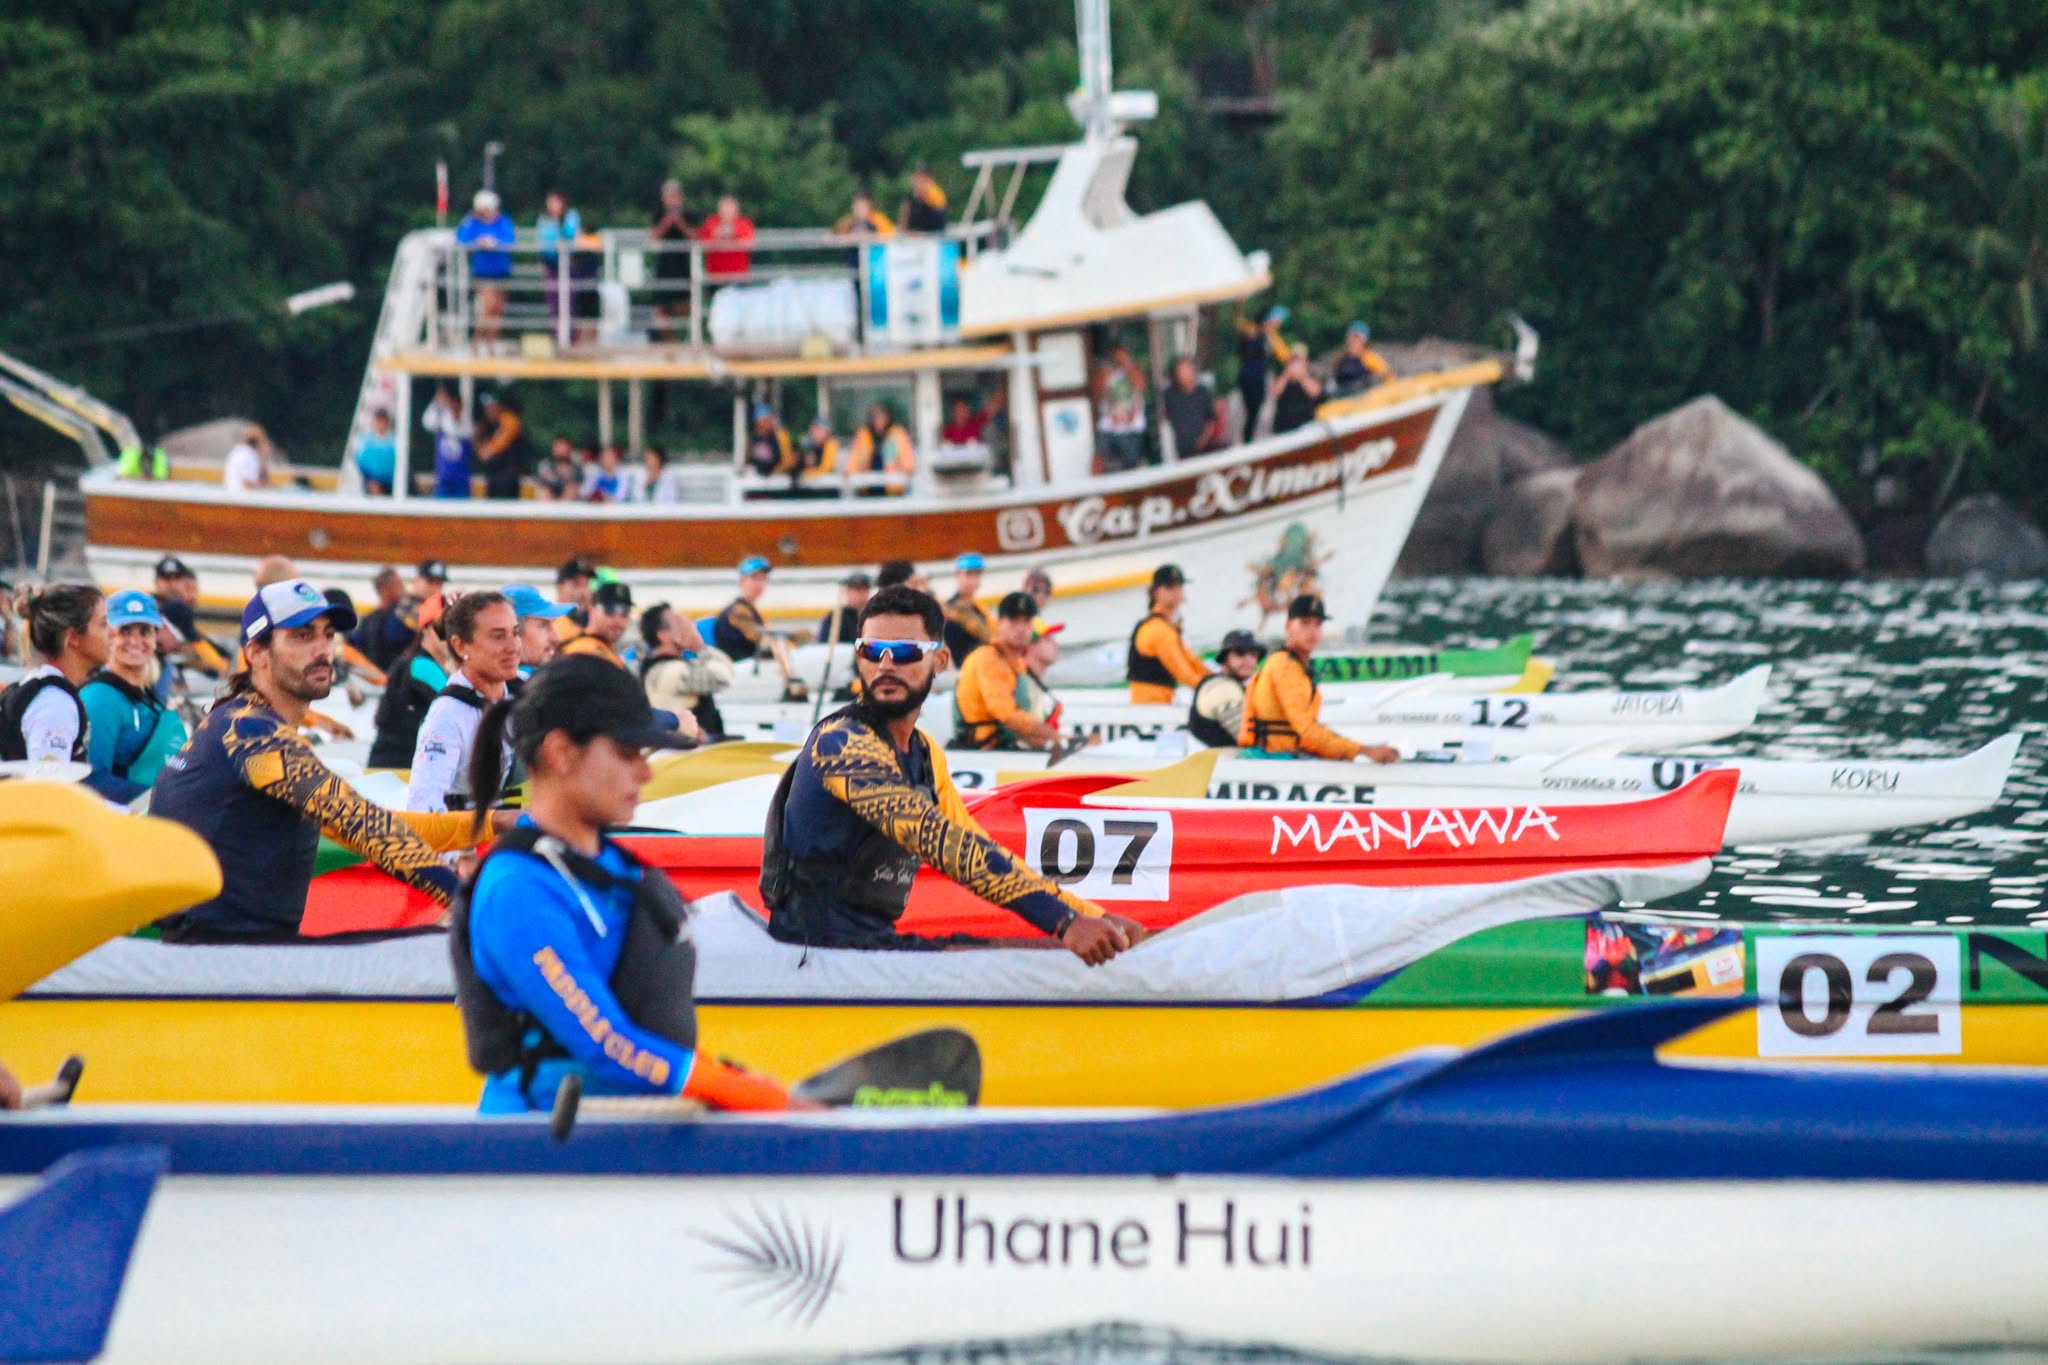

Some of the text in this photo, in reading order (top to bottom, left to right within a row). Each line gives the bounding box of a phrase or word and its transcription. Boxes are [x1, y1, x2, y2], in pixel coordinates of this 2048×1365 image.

[1057, 496, 1188, 546] Cap.
[1470, 698, 1530, 729] 12
[1830, 766, 1901, 793] KORU
[1040, 818, 1158, 885] 07
[1270, 804, 1561, 855] MANAWA
[1778, 952, 1940, 1037] 02
[892, 1193, 1312, 1268] Uhane Hui
